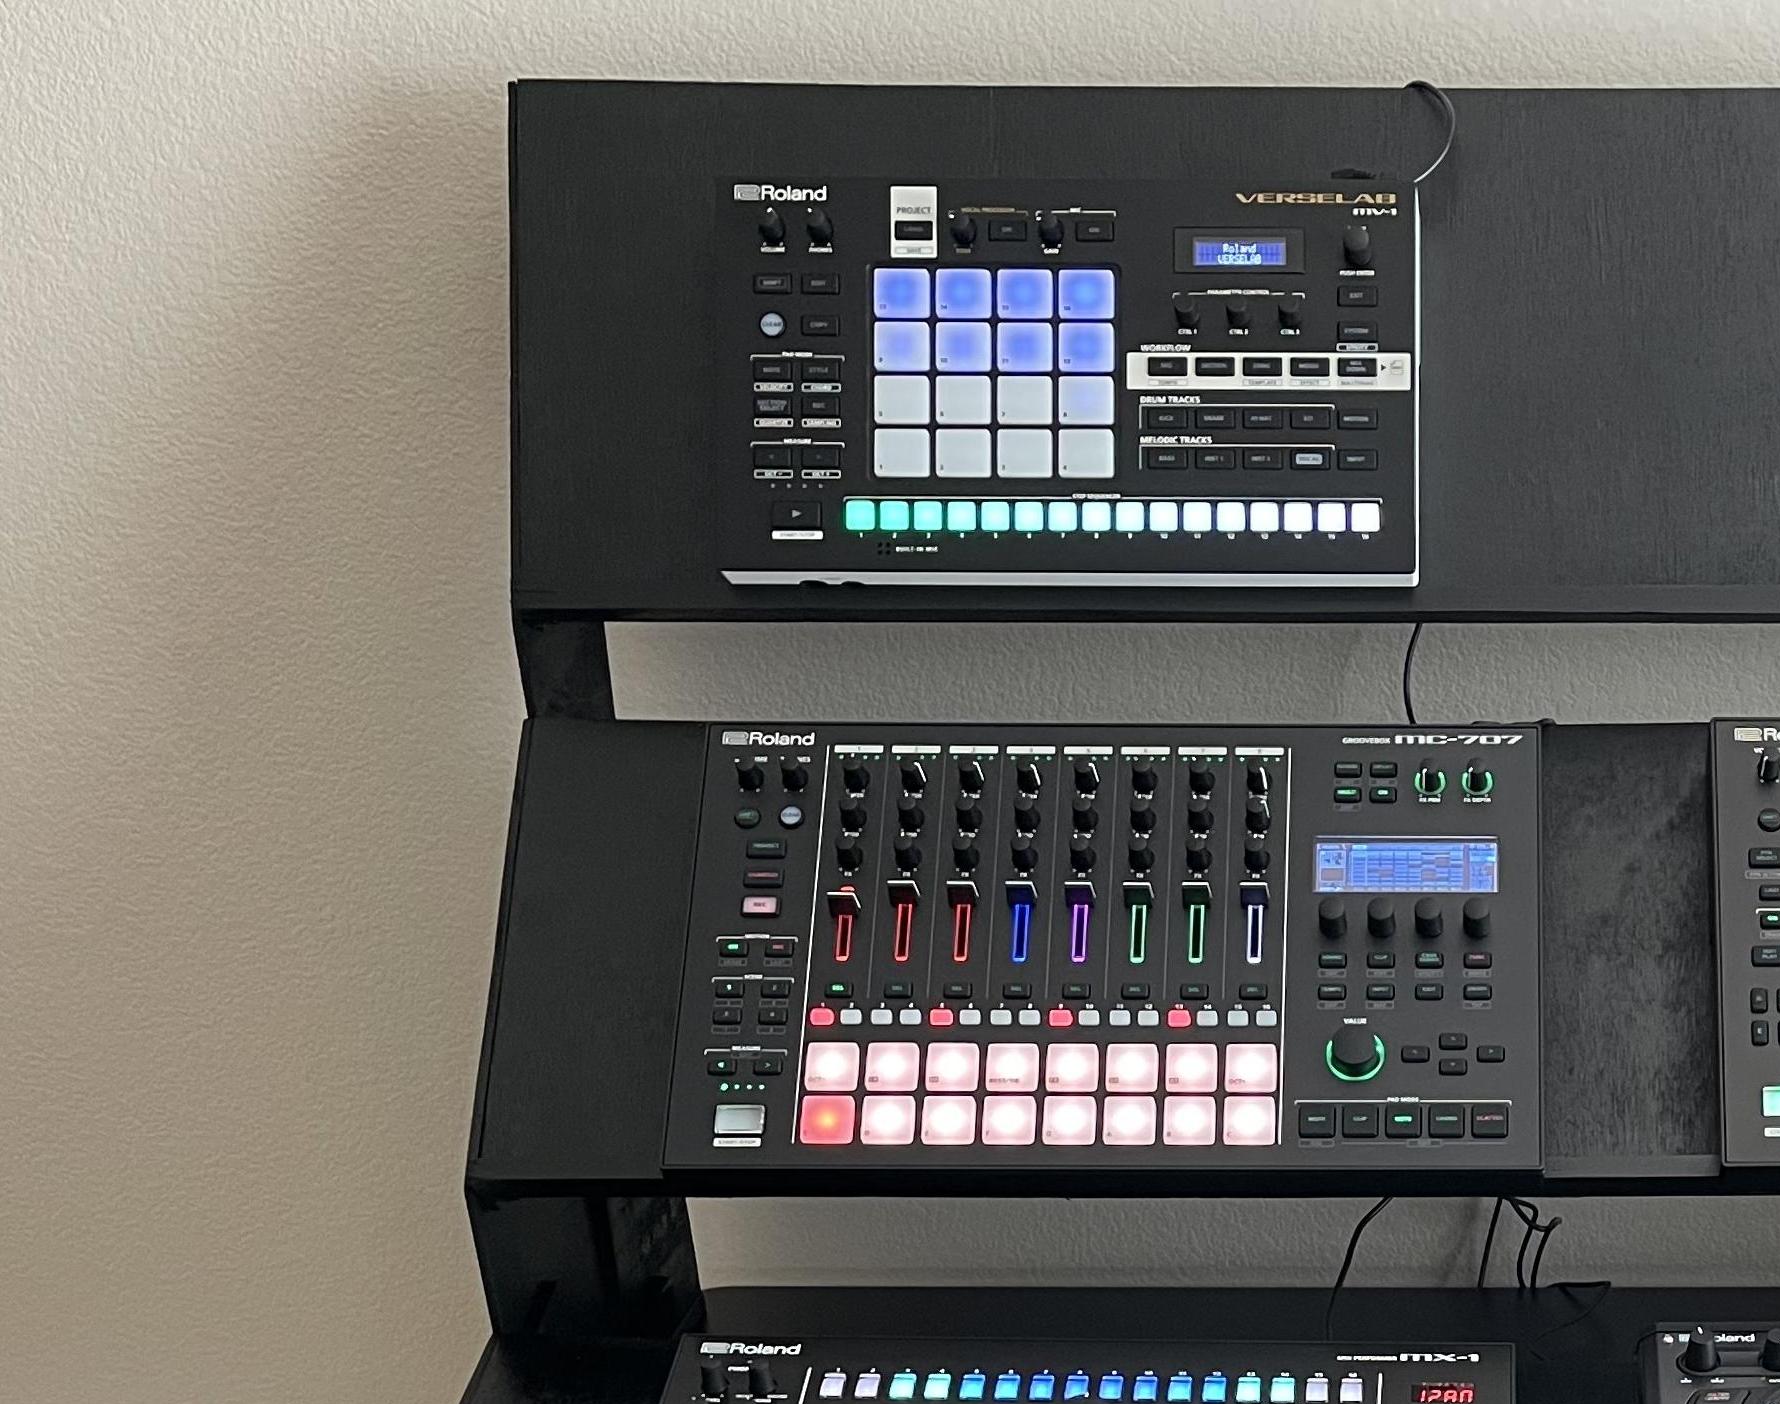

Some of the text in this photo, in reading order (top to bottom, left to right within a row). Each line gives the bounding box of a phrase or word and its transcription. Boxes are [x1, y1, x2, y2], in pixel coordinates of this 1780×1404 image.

[761, 185, 827, 201] Roland
[1236, 192, 1397, 205] VERSELAB
[896, 206, 931, 214] PROJECT
[1222, 243, 1257, 253] Roland
[1217, 254, 1262, 264] VERSELAB
[1140, 396, 1200, 404] DRUM TRACKS
[1140, 436, 1212, 444] MELODIC TRACKS
[749, 732, 816, 746] Roland
[1342, 735, 1524, 745] GROOVEBOX MC-707
[1715, 1333, 1755, 1343] oland
[730, 1343, 802, 1356] Roland
[1400, 1353, 1480, 1362] MX-1
